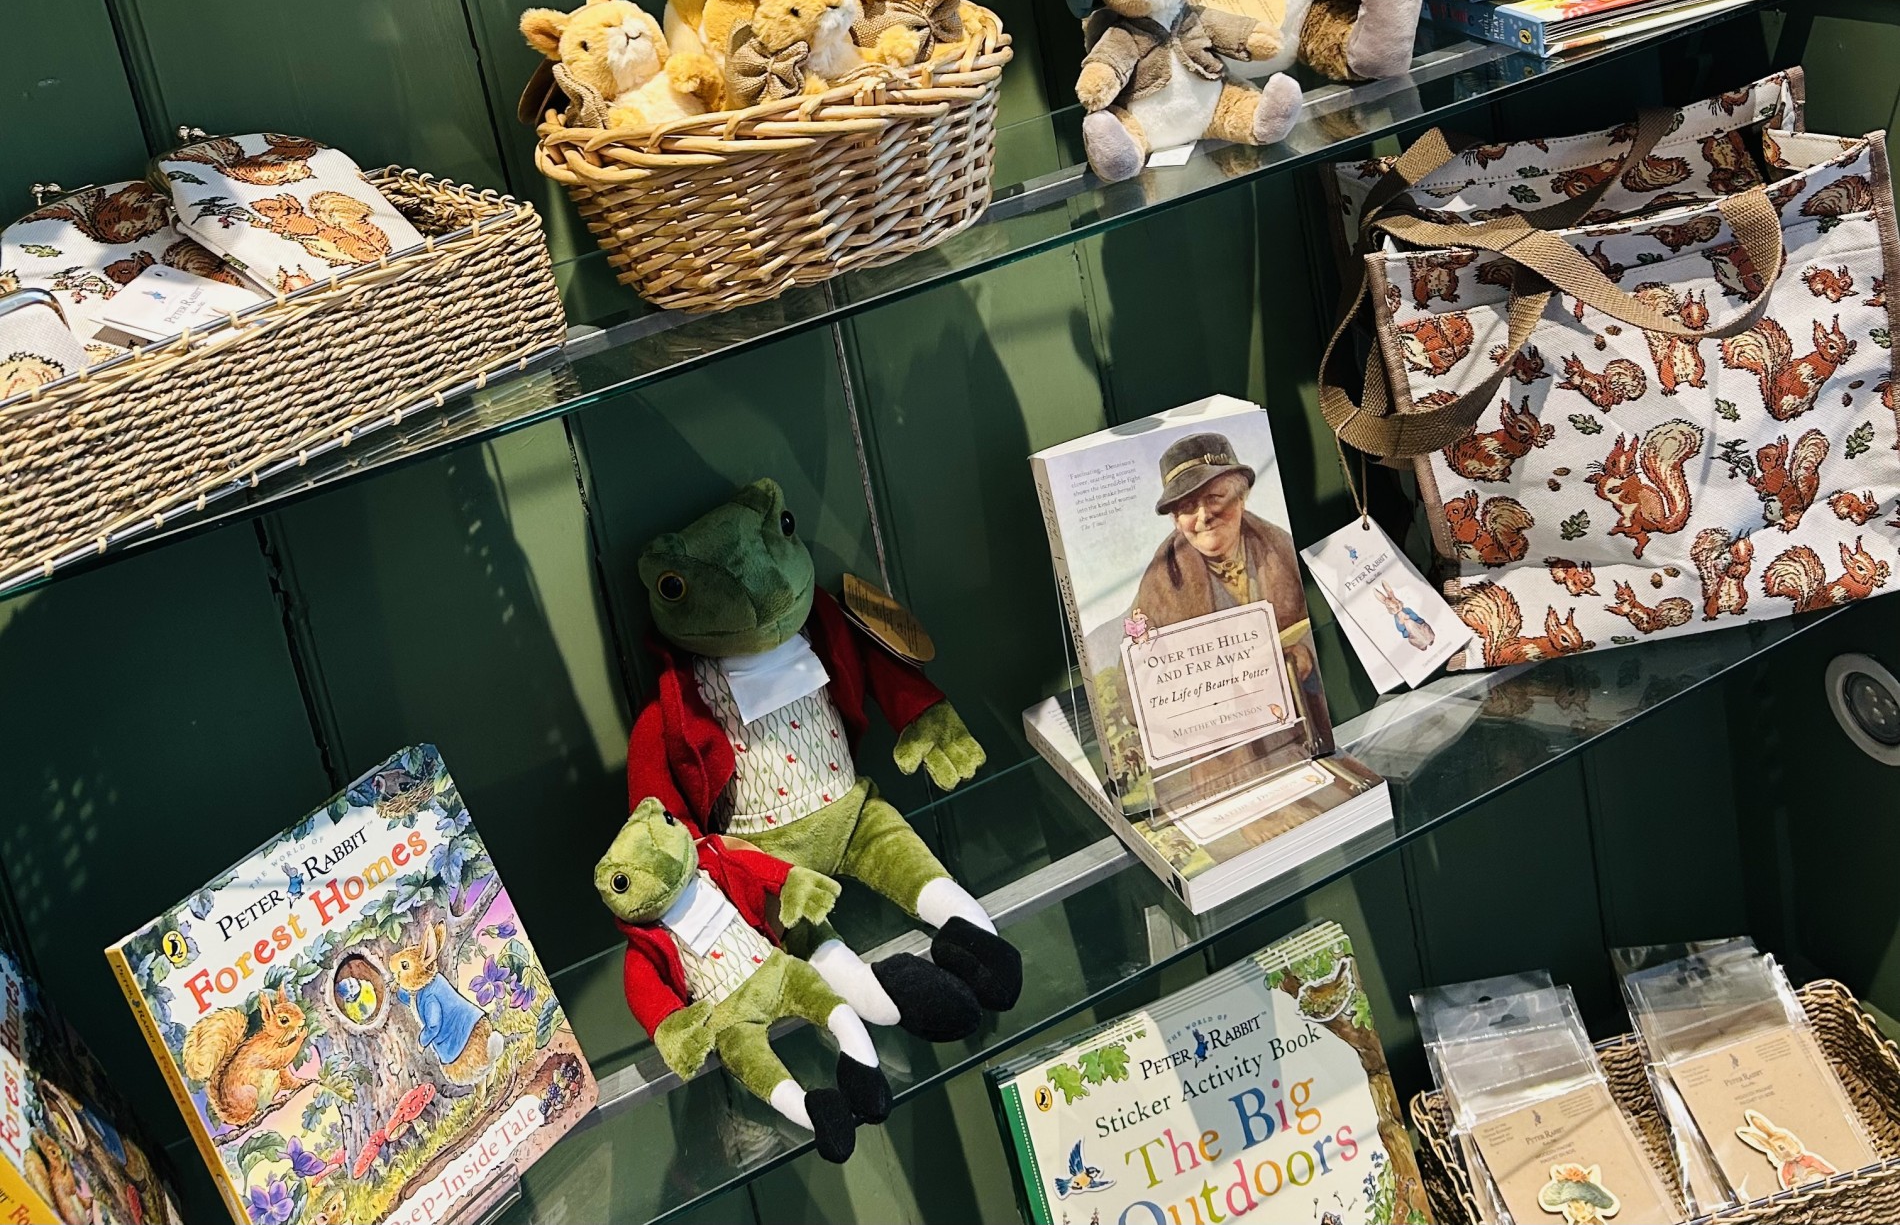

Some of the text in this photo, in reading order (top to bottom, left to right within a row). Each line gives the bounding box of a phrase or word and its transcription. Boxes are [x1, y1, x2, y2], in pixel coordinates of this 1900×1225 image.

[1344, 570, 1368, 591] PETER
[1363, 552, 1389, 574] RABBIT
[1187, 641, 1215, 657] THE
[1216, 629, 1259, 650] HILLS
[1149, 667, 1271, 709] The Life of Beatrix Potter
[1156, 668, 1182, 685] AND
[1184, 659, 1213, 676] FAR
[1171, 705, 1263, 739] MATTHEW DENNISON
[215, 825, 370, 943] PETER RABBIT
[249, 836, 325, 890] THE WORLD OF
[183, 829, 429, 1015] Forest Homes
[1139, 1014, 1262, 1081] PETER RABBIT
[1166, 1013, 1228, 1045] THE WORLD OF
[0, 973, 22, 1158] Forest Homes
[1094, 1022, 1324, 1139] Sticker Activity Book
[494, 1106, 538, 1147] Tale
[1125, 1077, 1324, 1190] The Big
